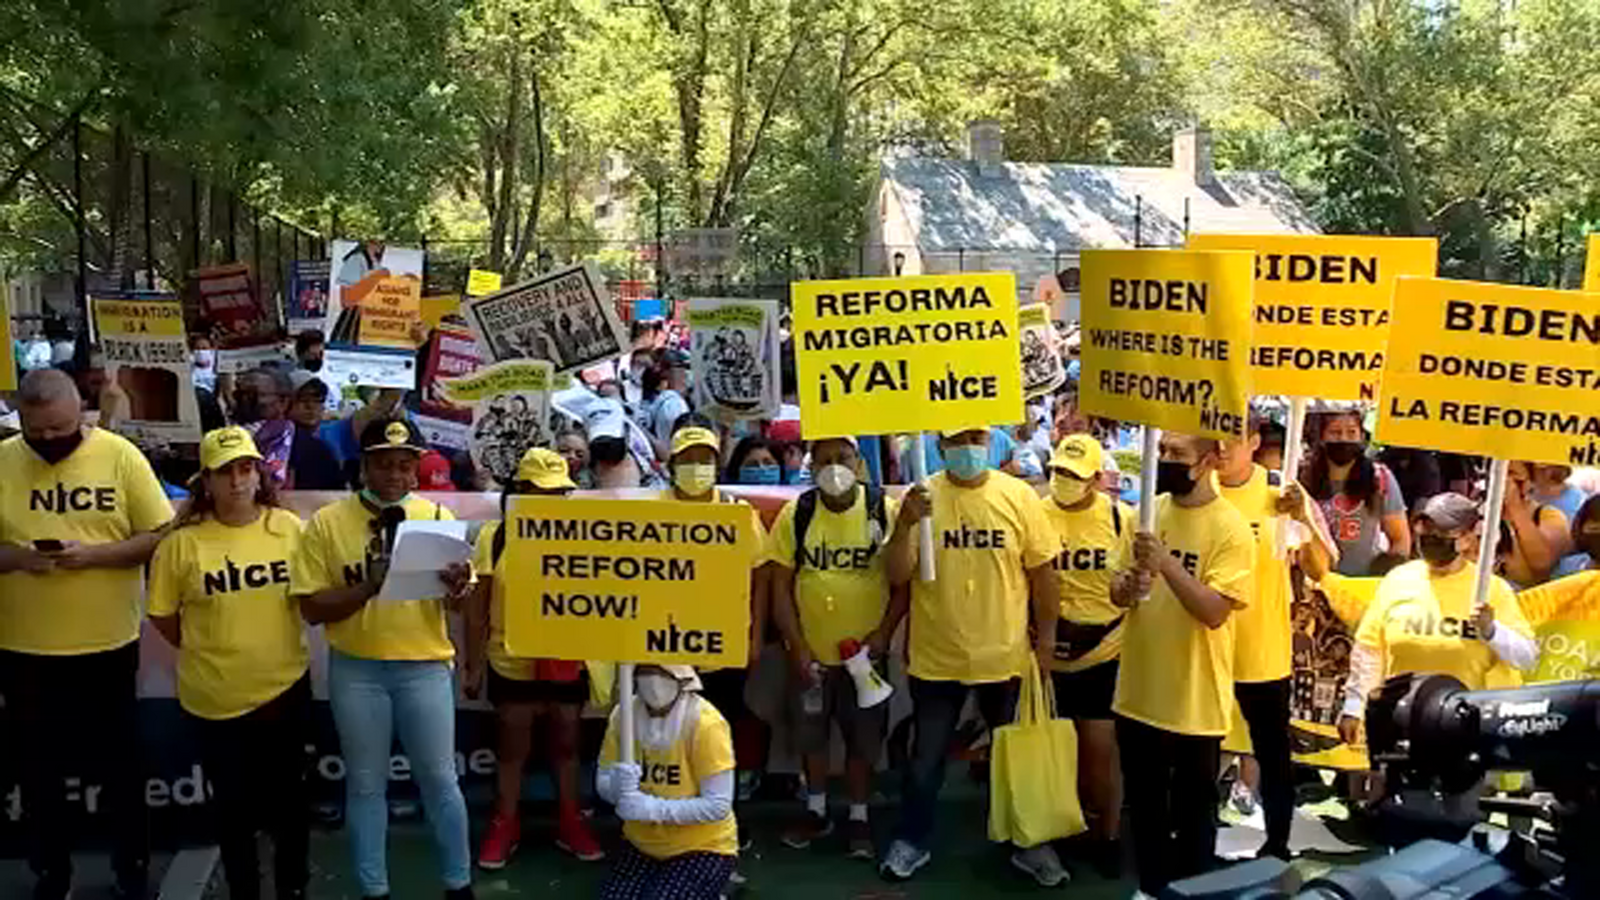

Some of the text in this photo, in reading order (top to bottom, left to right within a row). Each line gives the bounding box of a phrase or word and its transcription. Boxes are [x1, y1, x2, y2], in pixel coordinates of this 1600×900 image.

[481, 274, 583, 319] RECOVERY AND
[815, 285, 993, 318] REFORMA
[1108, 278, 1208, 314] BIDEN
[1253, 305, 1314, 326] NDE
[1445, 299, 1600, 345] BIDEN
[803, 319, 1009, 351] MIGRATORIA
[1089, 329, 1230, 361] WHERE IS THE
[818, 358, 910, 404] ¡YA!
[928, 366, 998, 402] NICE
[1418, 353, 1528, 384] DONDE
[1099, 370, 1215, 408] REFORM?
[1199, 405, 1244, 435] NICE
[1389, 398, 1600, 439] LA REFORMA
[29, 482, 116, 514] NICE
[516, 517, 738, 545] IMMIGRATION
[943, 521, 1006, 549] NICE
[540, 554, 696, 581] REFORM
[801, 537, 870, 571] NICE
[204, 557, 291, 595] NICE
[540, 593, 640, 619] NOW!
[646, 616, 723, 655] NICE
[1403, 611, 1478, 640] NICE
